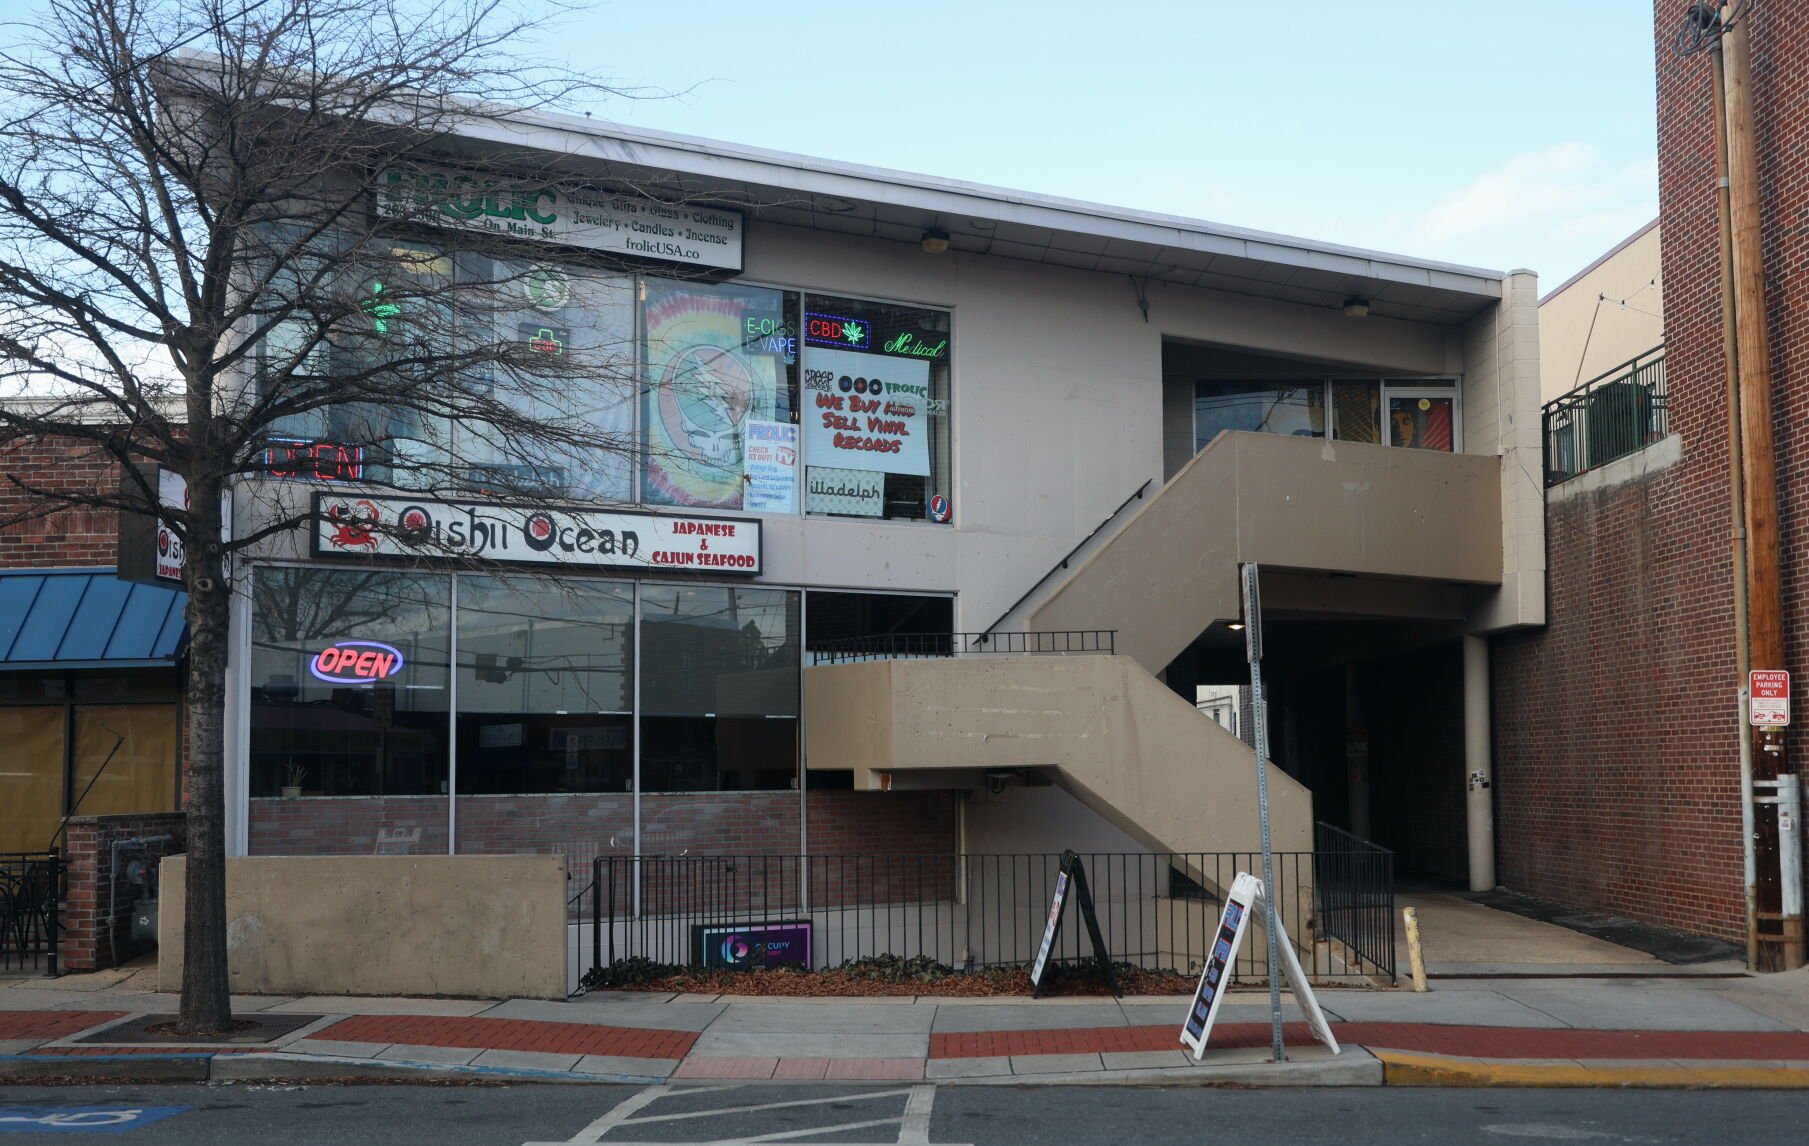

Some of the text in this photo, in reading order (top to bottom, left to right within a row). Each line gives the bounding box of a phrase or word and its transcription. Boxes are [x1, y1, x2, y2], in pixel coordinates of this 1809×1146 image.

[483, 218, 500, 232] On
[507, 222, 534, 236] Main
[692, 212, 734, 231] Clothing
[631, 220, 674, 237] Candles
[685, 228, 728, 245] Incense
[626, 237, 700, 259] frolicUSA.co
[810, 320, 842, 338] CBD
[885, 333, 947, 358] Medical
[884, 382, 928, 398] FROLIC
[815, 392, 844, 410] WE
[848, 395, 881, 415] BUY
[748, 423, 797, 443] FROLIC
[822, 412, 910, 436] SELL VINYL
[833, 431, 902, 454] RECORDS
[810, 481, 880, 501] illadelph
[399, 504, 639, 560] Oishii Ocean
[671, 521, 736, 538] JAPANESE
[699, 538, 709, 551] &
[651, 550, 756, 569] CAJUN SEAFOOD
[317, 647, 395, 679] OPEN
[1753, 673, 1786, 681] EMPLOYEE
